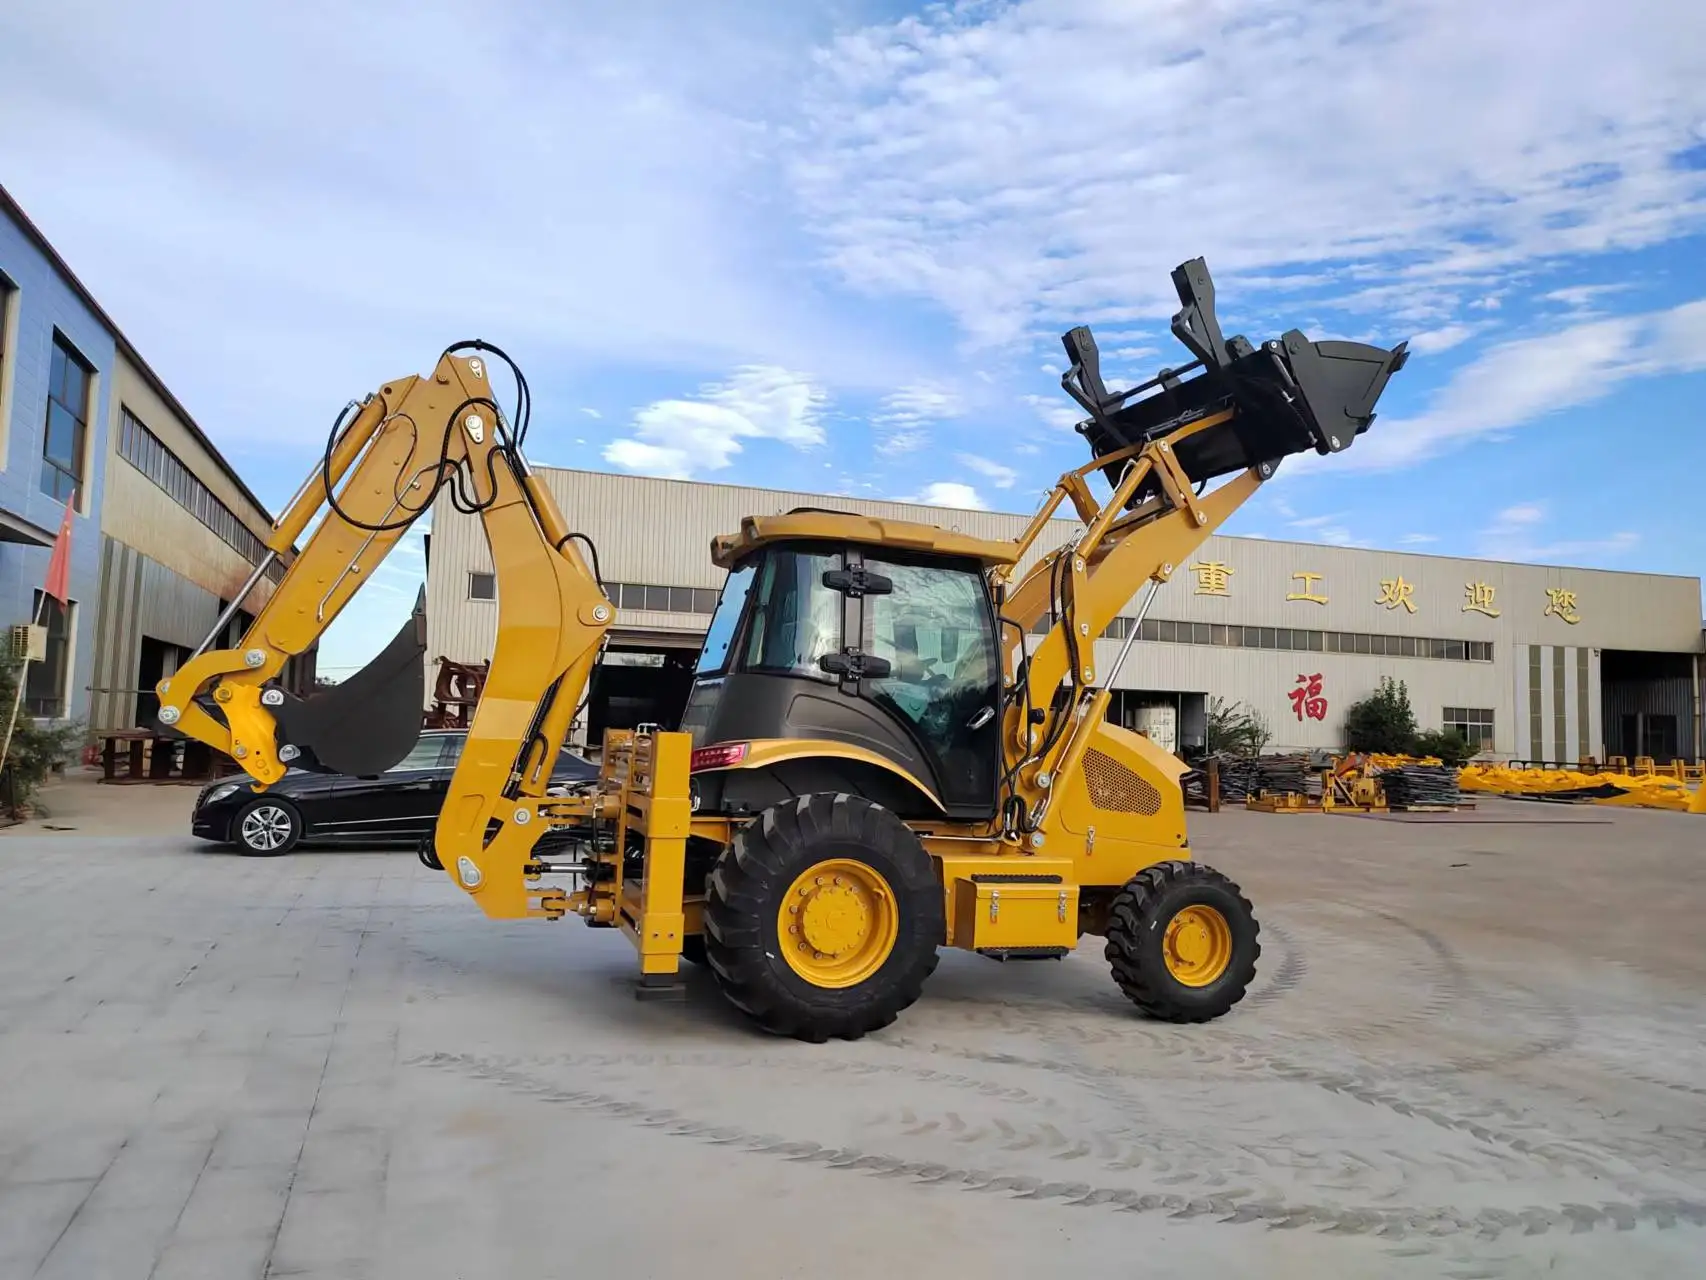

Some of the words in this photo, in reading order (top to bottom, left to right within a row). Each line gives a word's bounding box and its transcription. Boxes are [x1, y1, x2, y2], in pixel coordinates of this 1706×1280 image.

[1189, 561, 1580, 625] 重工欢迎您
[1287, 672, 1328, 721] 福
